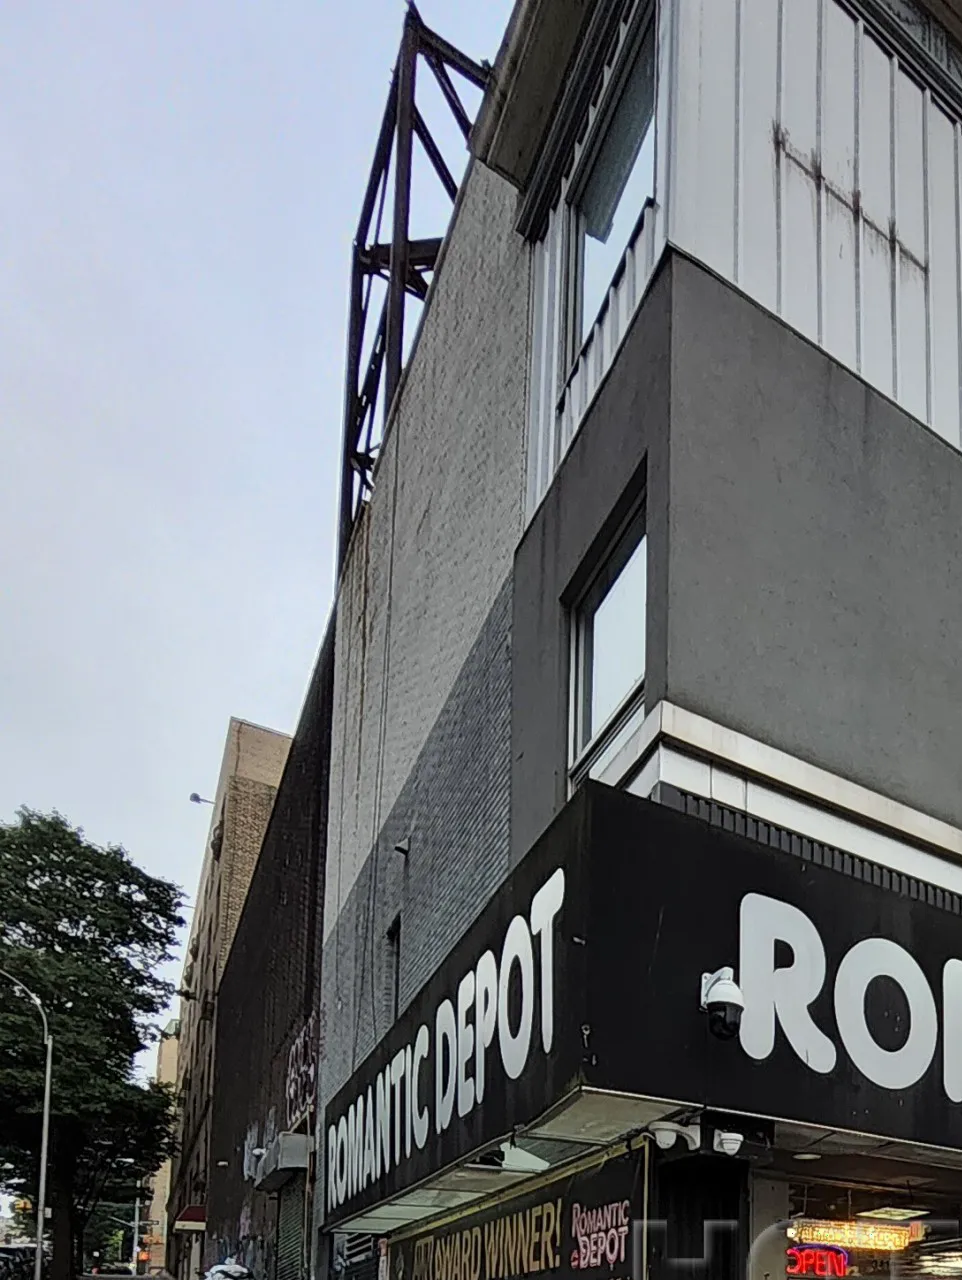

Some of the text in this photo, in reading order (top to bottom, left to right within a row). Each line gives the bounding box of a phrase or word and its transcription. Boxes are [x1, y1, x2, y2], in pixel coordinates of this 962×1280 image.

[327, 1023, 430, 1214] ROMANTIC
[434, 867, 565, 1135] DEPOT
[572, 1199, 631, 1269] ROMANTIC DEPOT
[786, 1248, 846, 1278] OPEN
